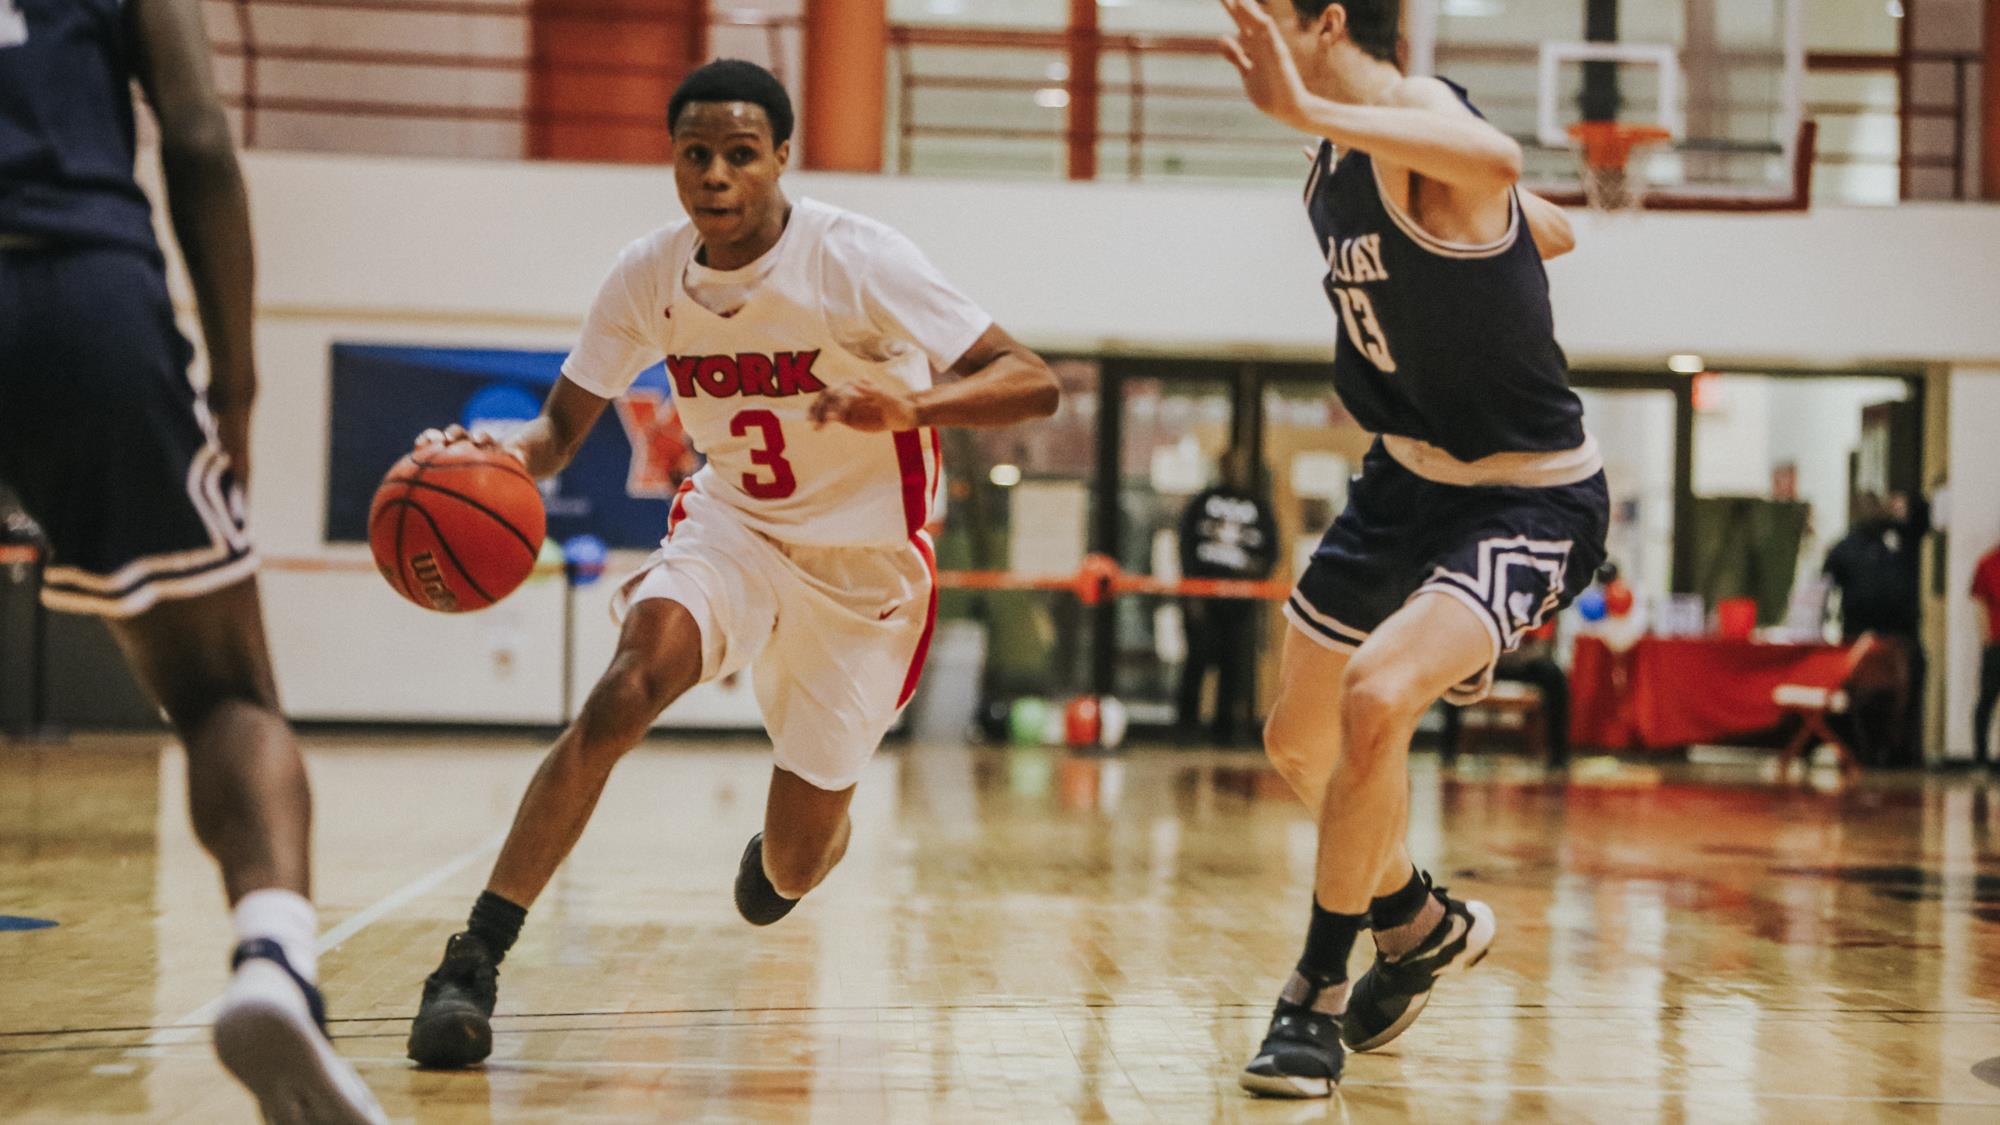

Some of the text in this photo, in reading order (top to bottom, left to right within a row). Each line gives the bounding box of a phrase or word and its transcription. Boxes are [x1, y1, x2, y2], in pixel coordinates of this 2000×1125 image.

[666, 348, 827, 398] YORK
[1333, 287, 1397, 374] 13
[730, 409, 797, 501] 3
